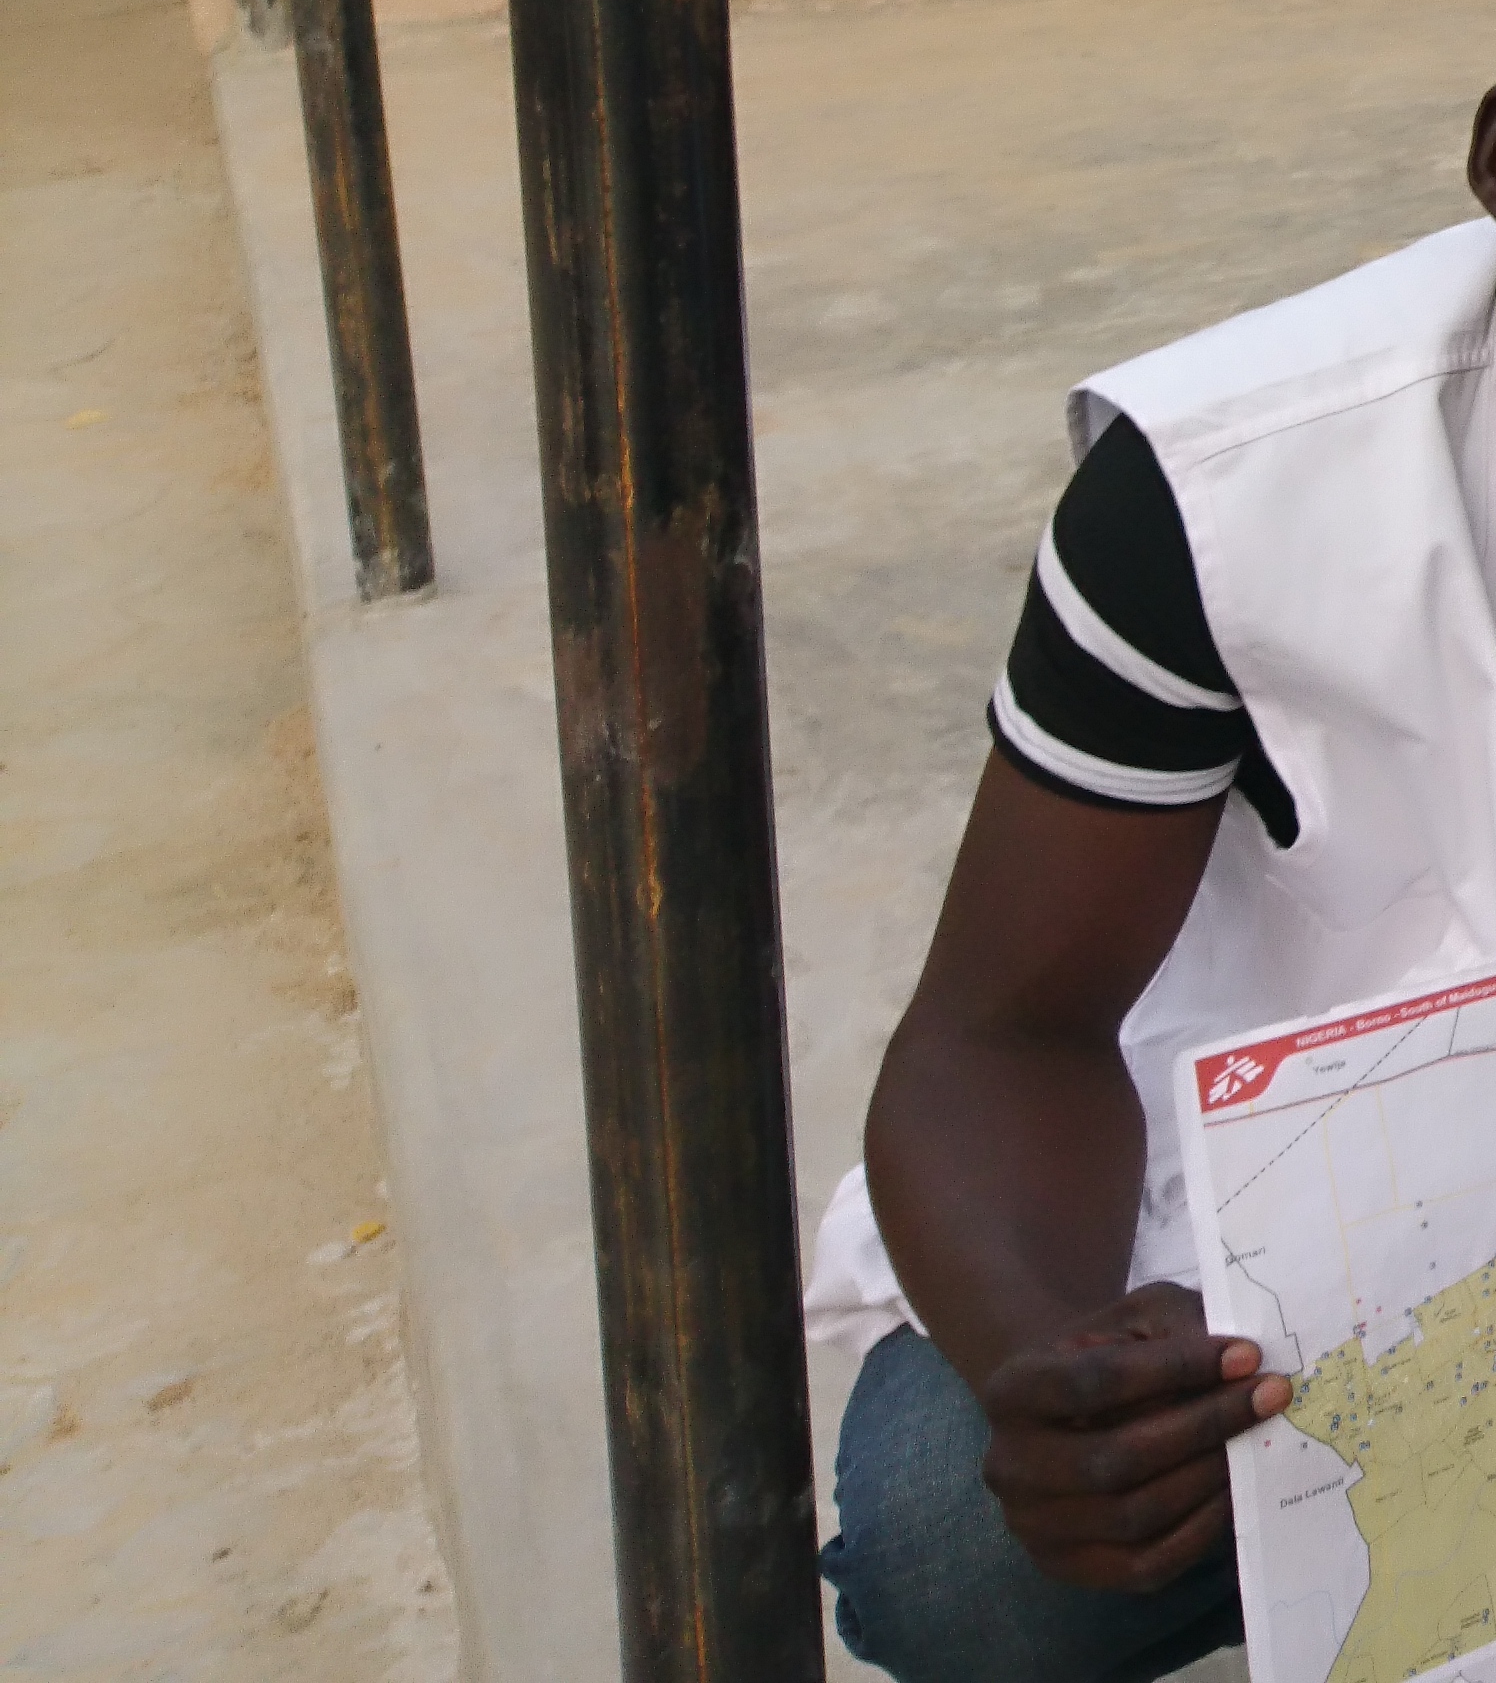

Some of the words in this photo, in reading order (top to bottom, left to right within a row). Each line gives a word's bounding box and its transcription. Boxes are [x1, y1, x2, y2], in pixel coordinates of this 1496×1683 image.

[1295, 1024, 1346, 1047] NIGERIA
[1354, 1011, 1392, 1030] Borno
[1399, 999, 1434, 1017] South
[1433, 995, 1447, 1007] of
[1280, 1491, 1306, 1510] Dala
